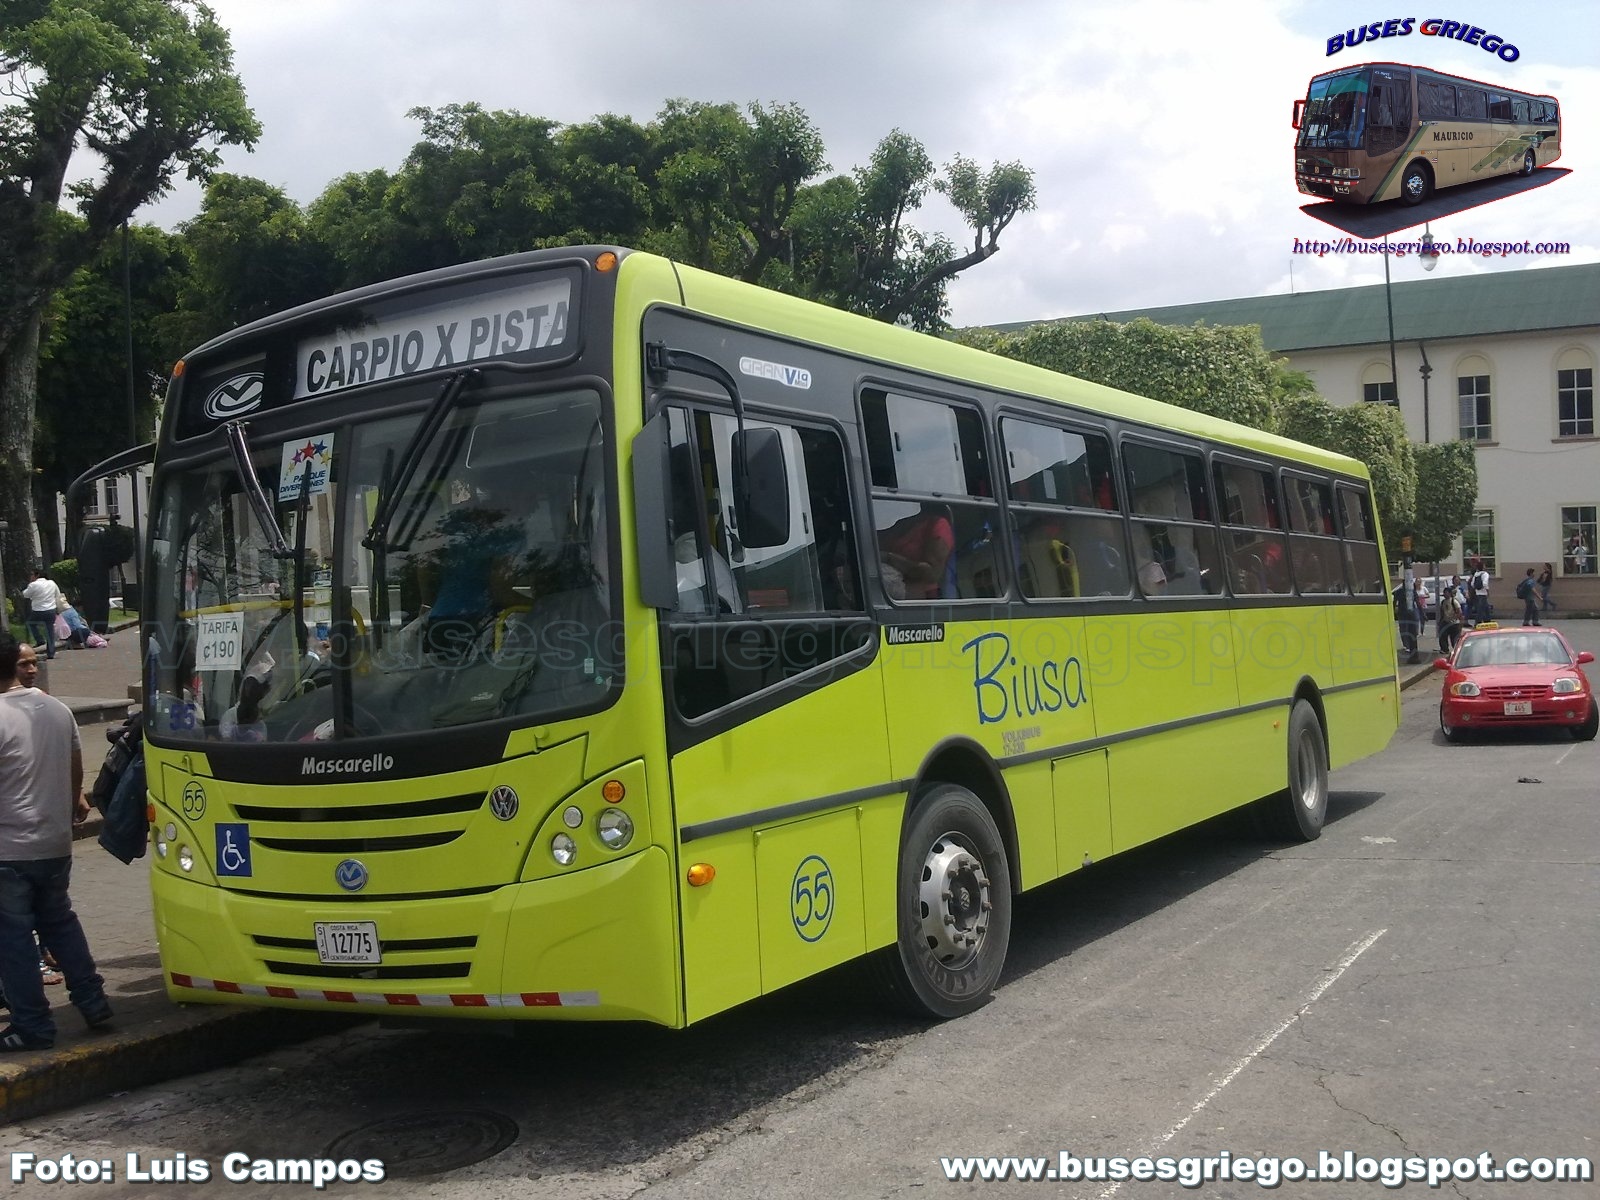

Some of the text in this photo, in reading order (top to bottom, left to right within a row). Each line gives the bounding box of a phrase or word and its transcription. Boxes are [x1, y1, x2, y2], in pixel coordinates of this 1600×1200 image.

[306, 300, 570, 392] CARPIO X PISTA
[293, 469, 326, 483] PAQUE
[202, 620, 238, 635] TARIFA
[888, 624, 943, 643] Mascarello
[961, 632, 1087, 725] Biusa
[301, 753, 394, 775] Mascarello
[184, 788, 205, 813] 55
[795, 870, 831, 927] 55
[331, 932, 372, 954] 12775
